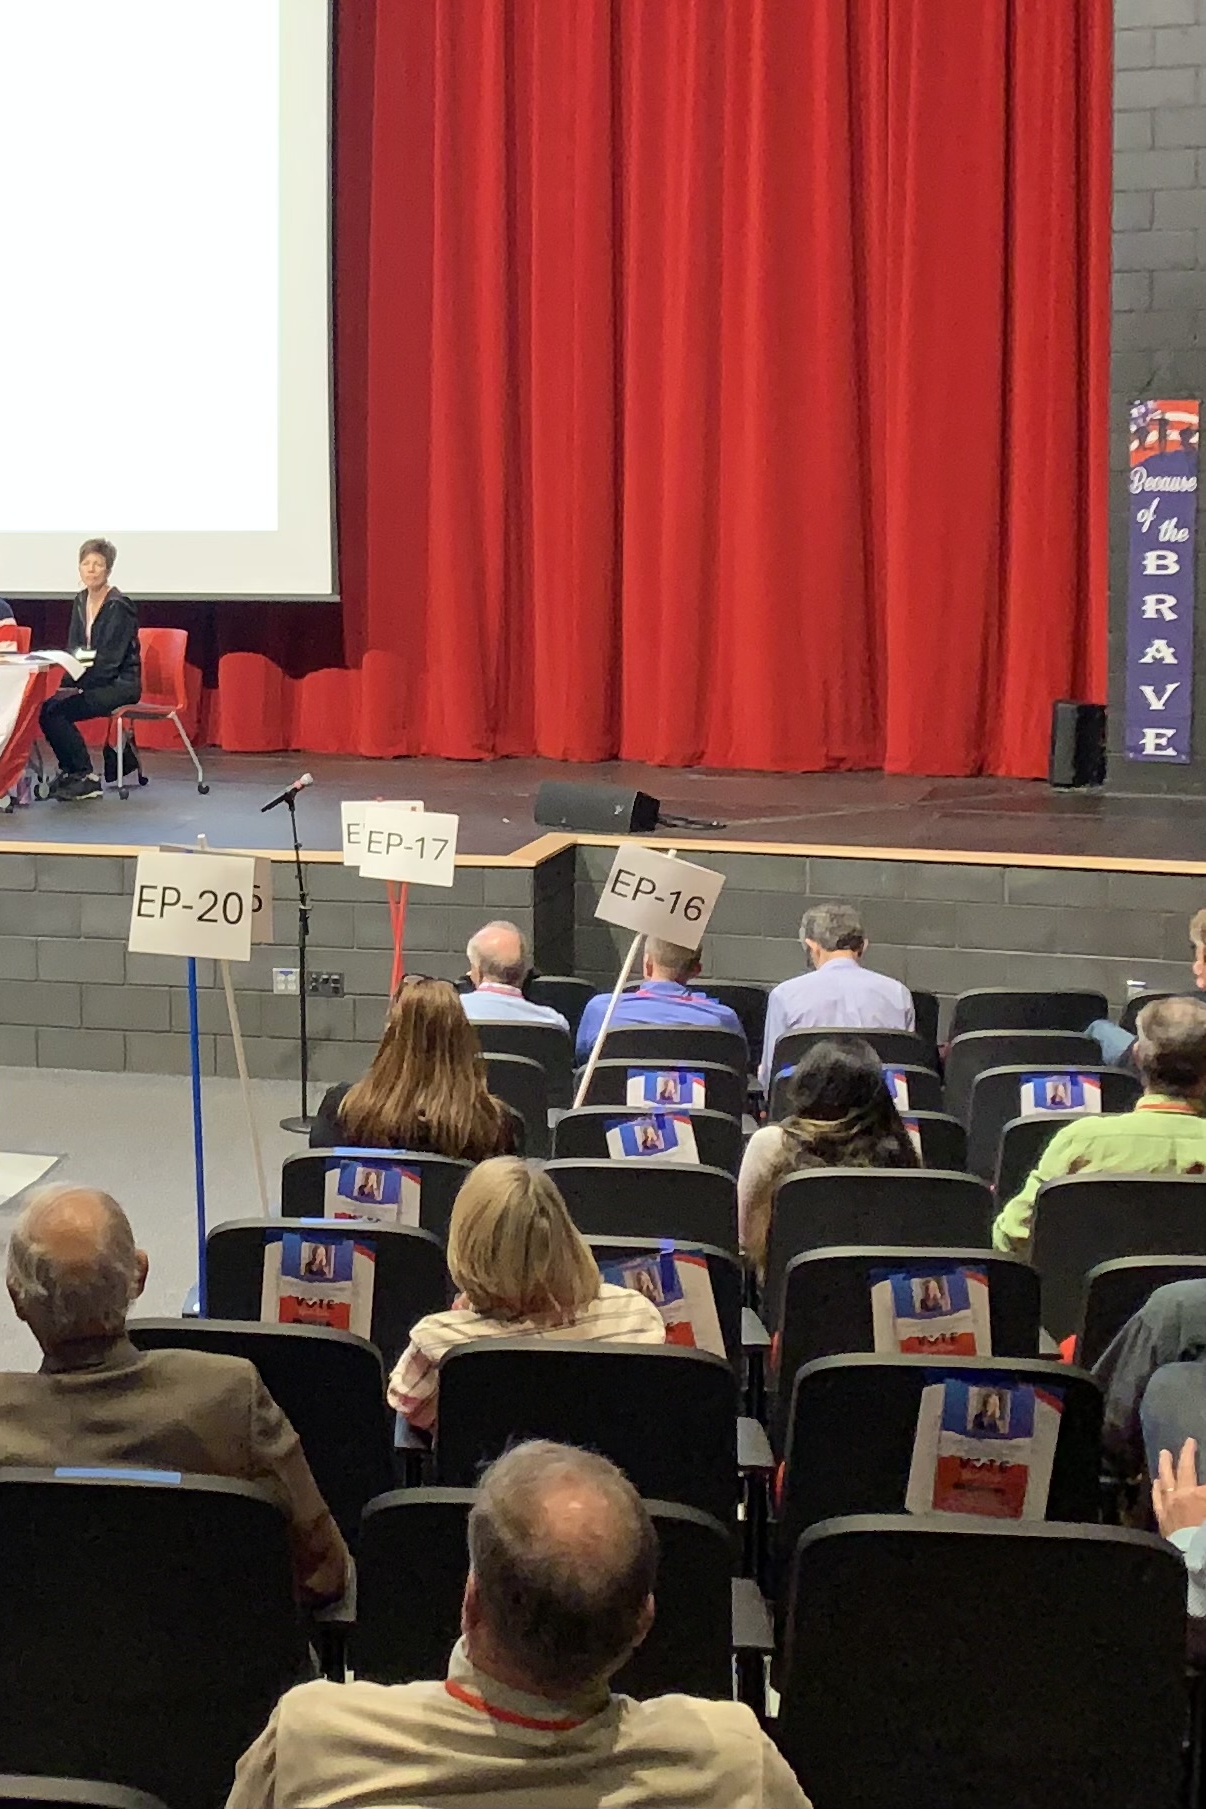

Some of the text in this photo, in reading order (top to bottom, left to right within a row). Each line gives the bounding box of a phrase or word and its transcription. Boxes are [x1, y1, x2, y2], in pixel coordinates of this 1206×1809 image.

[1129, 466, 1197, 494] Because
[1136, 497, 1190, 543] of the
[1138, 550, 1181, 756] BRAVE
[367, 830, 449, 861] EP-17
[136, 884, 244, 925] EP-20
[610, 868, 705, 921] EP-16
